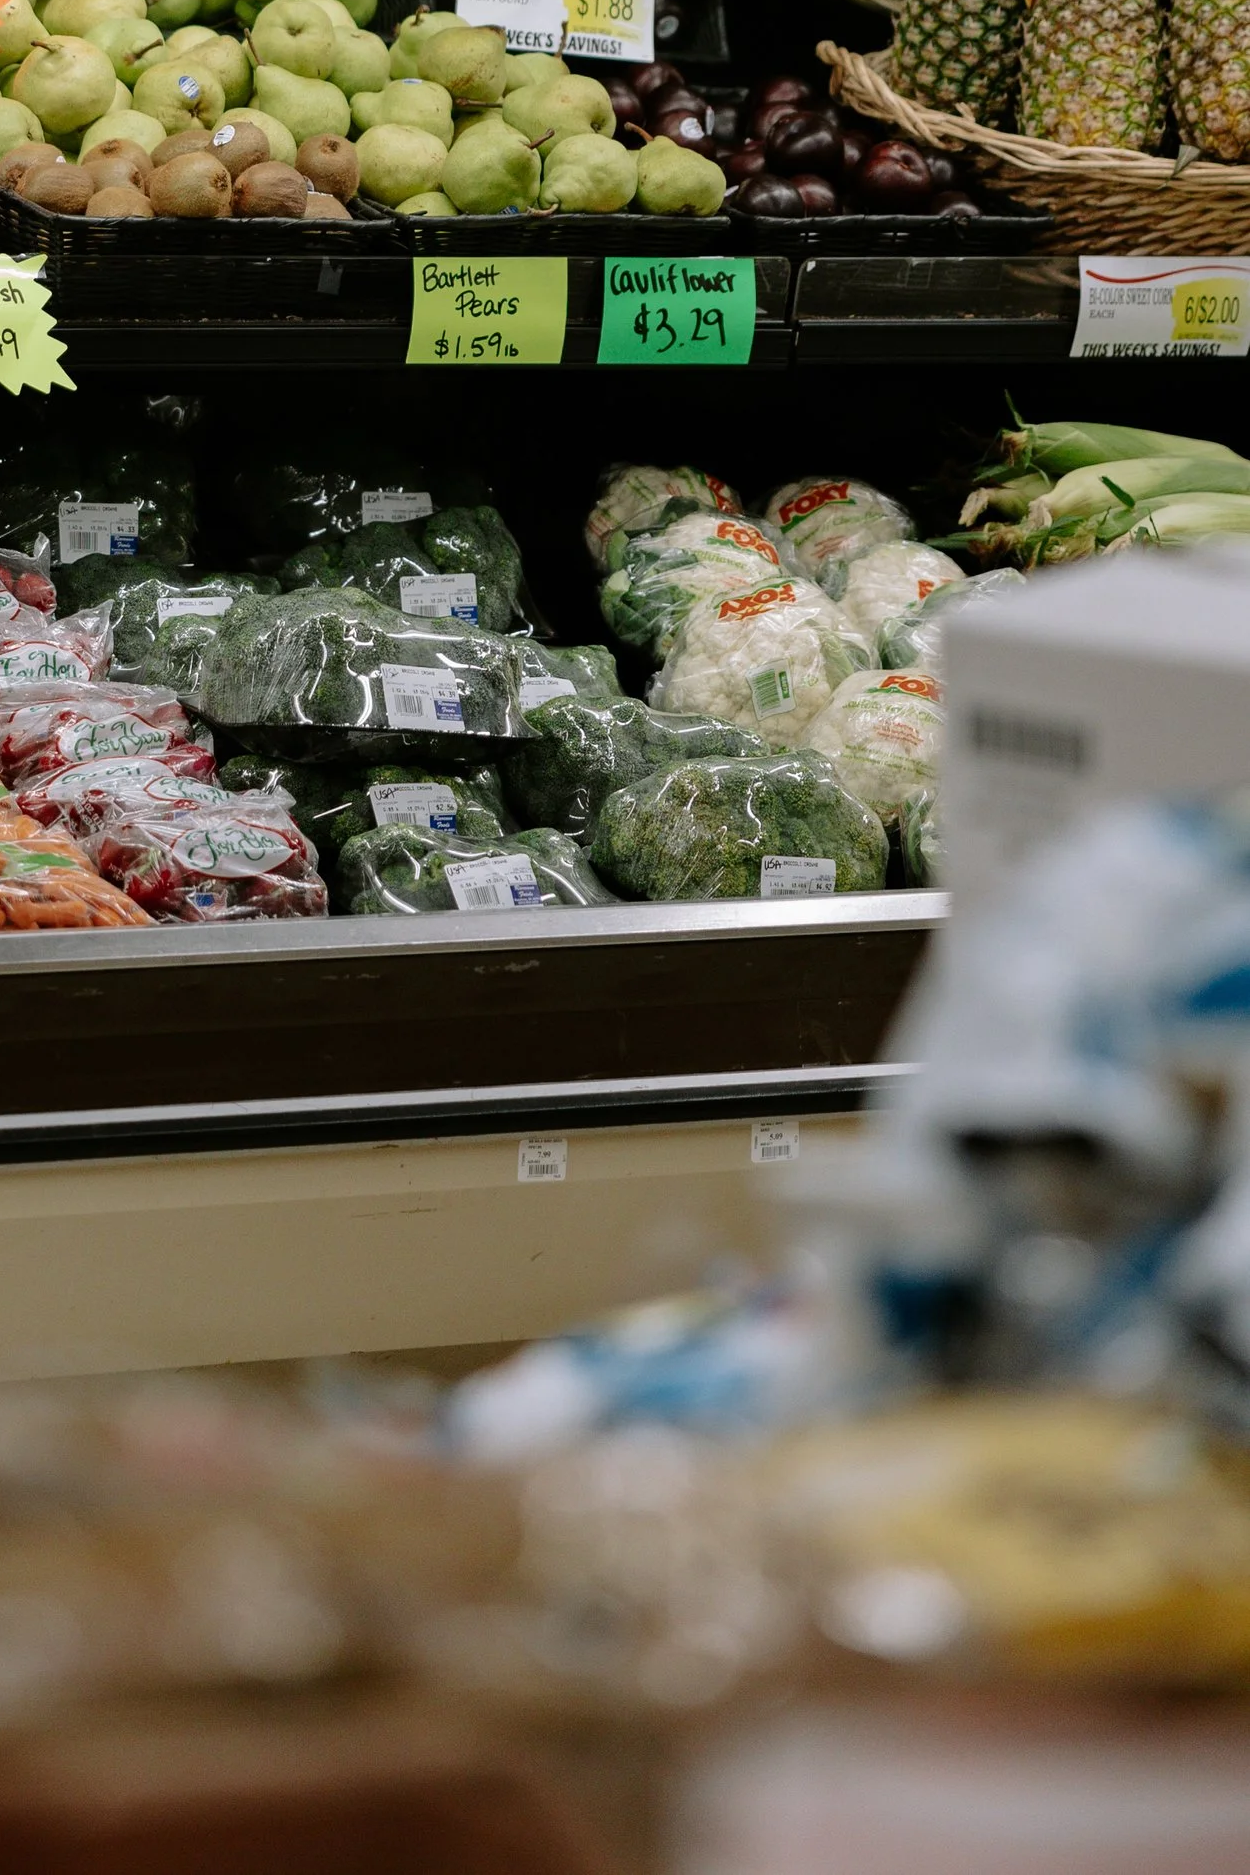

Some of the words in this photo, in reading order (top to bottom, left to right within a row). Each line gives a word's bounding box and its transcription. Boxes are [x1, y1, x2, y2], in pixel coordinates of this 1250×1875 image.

[567, 35, 623, 55] AVINGS!
[422, 263, 501, 293] Bartlett
[455, 290, 520, 318] Pears
[1088, 309, 1116, 320] EACH
[1184, 295, 1241, 326] 6/$2.00
[633, 302, 727, 354] $3.29
[1081, 342, 1108, 357] THIS
[1113, 342, 1158, 357] WEEK'S
[1161, 342, 1221, 357] SAVINGS!
[778, 481, 851, 525] FOXY
